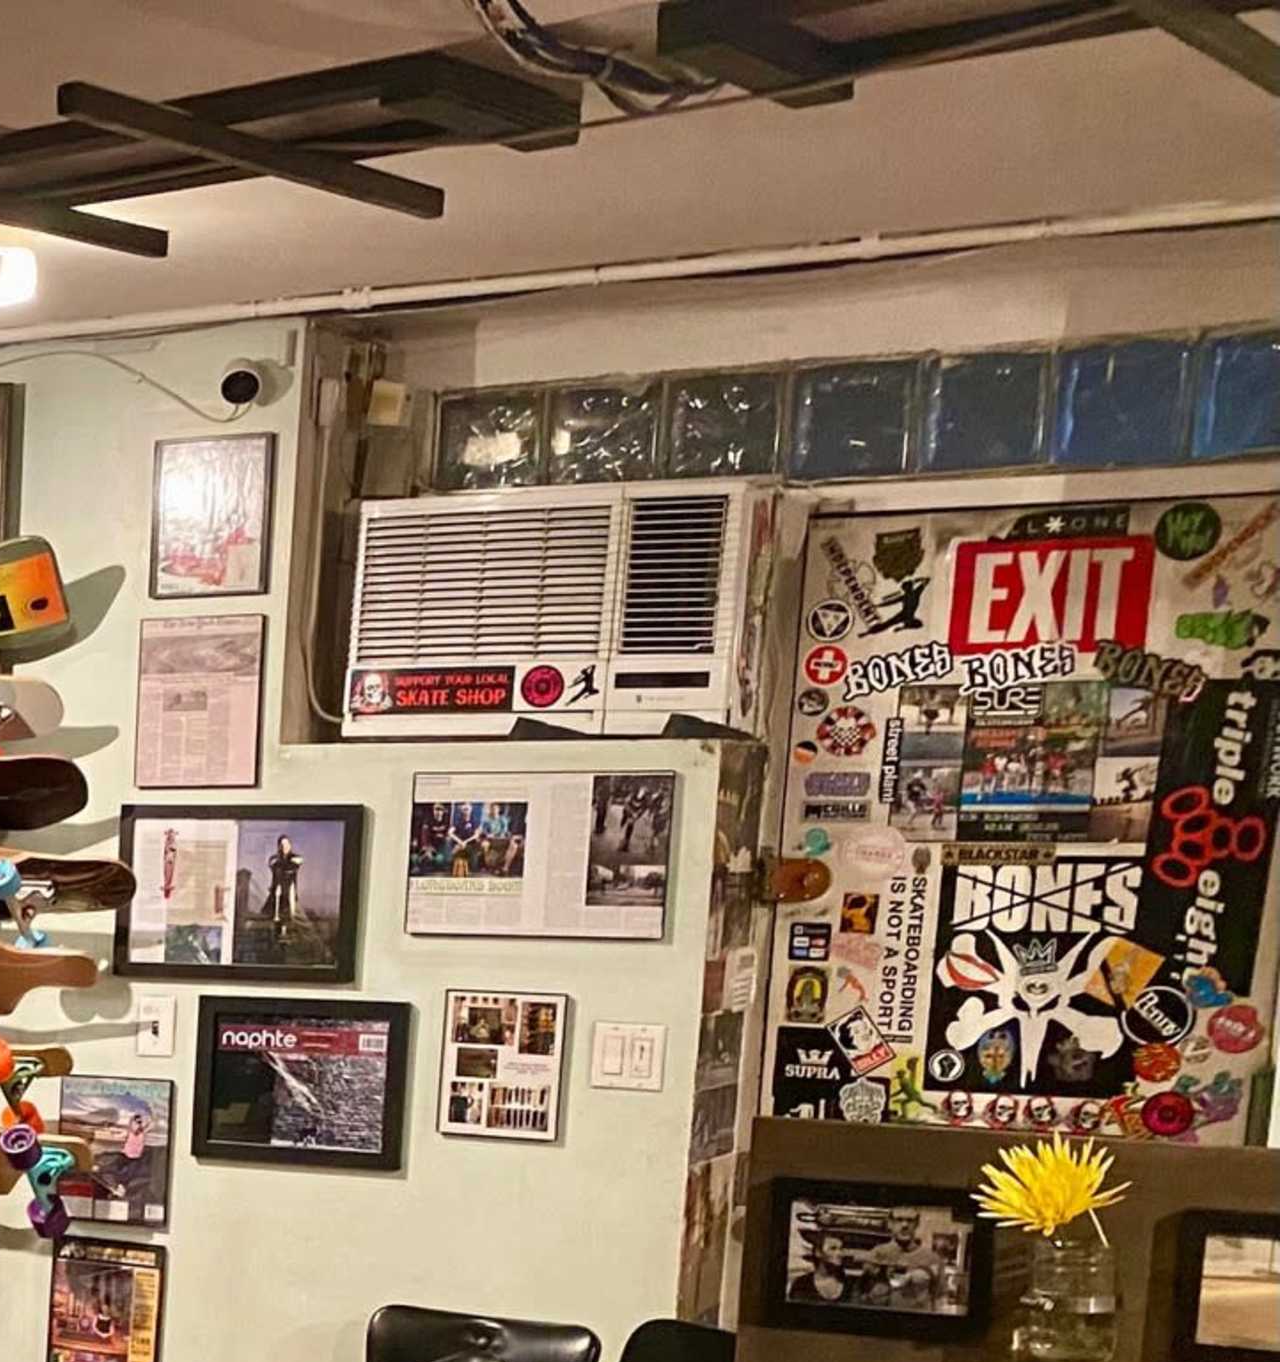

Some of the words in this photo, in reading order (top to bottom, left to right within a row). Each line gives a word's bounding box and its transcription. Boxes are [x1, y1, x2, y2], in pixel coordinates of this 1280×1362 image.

[967, 547, 1135, 644] EXIT
[394, 675, 441, 688] SUPPORT
[445, 674, 472, 686] YOUR
[475, 672, 509, 685] LOCAL
[843, 641, 953, 700] BONES
[961, 643, 1075, 694] BONES
[1093, 638, 1207, 702] BONES
[396, 689, 450, 707] SKATE
[456, 687, 507, 706] SHOP
[885, 719, 903, 763] street
[1213, 691, 1258, 806] triple
[958, 846, 1039, 861] BLACKSTAR
[892, 876, 907, 895] IS
[952, 862, 1142, 933] BONES
[887, 900, 904, 941] NOT
[1182, 869, 1225, 985] eigh
[884, 947, 899, 960] A
[898, 876, 928, 1032] SKATEBOARDING
[878, 966, 898, 1030] SPORT
[221, 1029, 298, 1049] naphte
[785, 1064, 841, 1079] SUPRA
